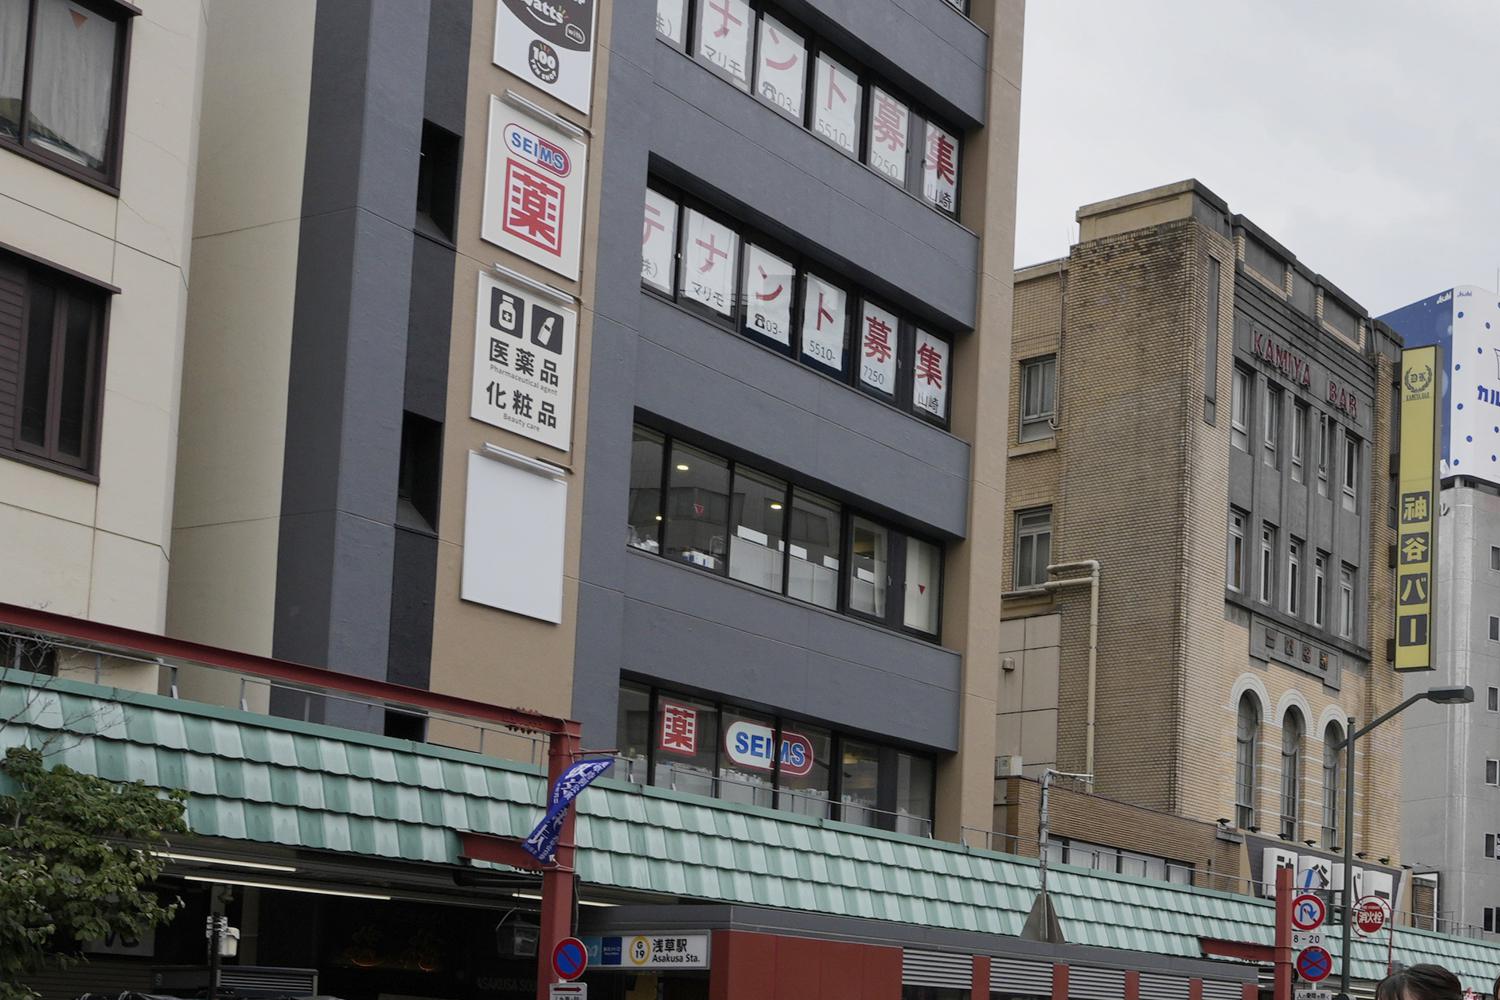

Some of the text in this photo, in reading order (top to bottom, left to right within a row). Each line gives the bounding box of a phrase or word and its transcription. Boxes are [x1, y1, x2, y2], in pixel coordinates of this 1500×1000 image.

[533, 46, 556, 70] 100
[511, 131, 563, 170] SEIMS
[508, 170, 559, 247] 薬
[691, 281, 725, 308] マリモ
[863, 366, 886, 386] 7250
[489, 336, 559, 388] 医薬品
[1253, 330, 1358, 419] KAMIYA BAR
[489, 363, 559, 397] Pharmaceutical agent
[486, 380, 557, 430] 化粧品
[503, 413, 541, 432] Beauty care
[1401, 496, 1429, 644] 神谷バー
[665, 707, 694, 749] 薬
[735, 731, 805, 766] SEIMS
[1359, 910, 1384, 924] 消火栓
[635, 950, 646, 960] 19
[636, 941, 643, 950] G
[652, 938, 688, 953] 浅草駅
[652, 953, 701, 964] Asakusa Sta.
